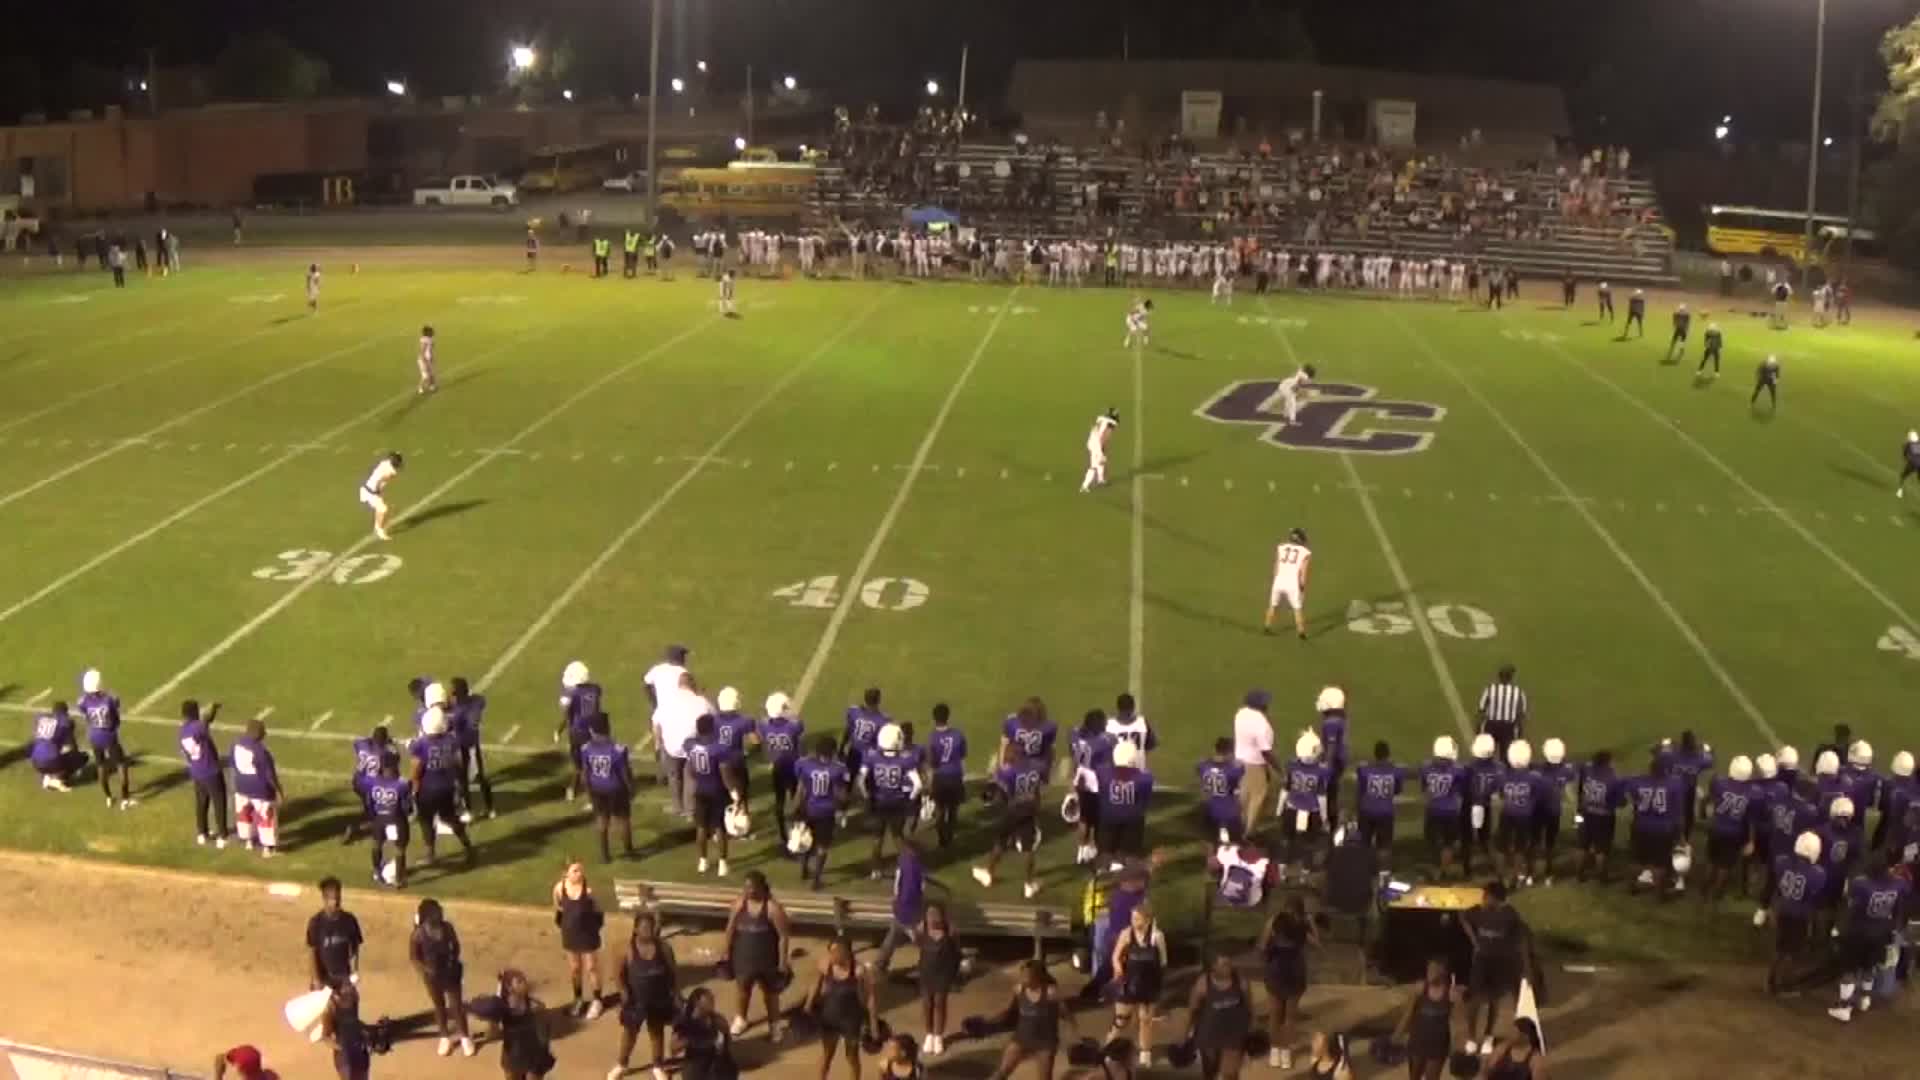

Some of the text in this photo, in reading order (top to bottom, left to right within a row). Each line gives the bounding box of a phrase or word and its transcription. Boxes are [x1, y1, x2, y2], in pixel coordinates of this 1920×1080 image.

[1191, 378, 1448, 455] CC
[250, 548, 403, 585] 30
[1280, 546, 1300, 564] 33
[772, 575, 930, 612] 40
[1347, 600, 1498, 640] 50
